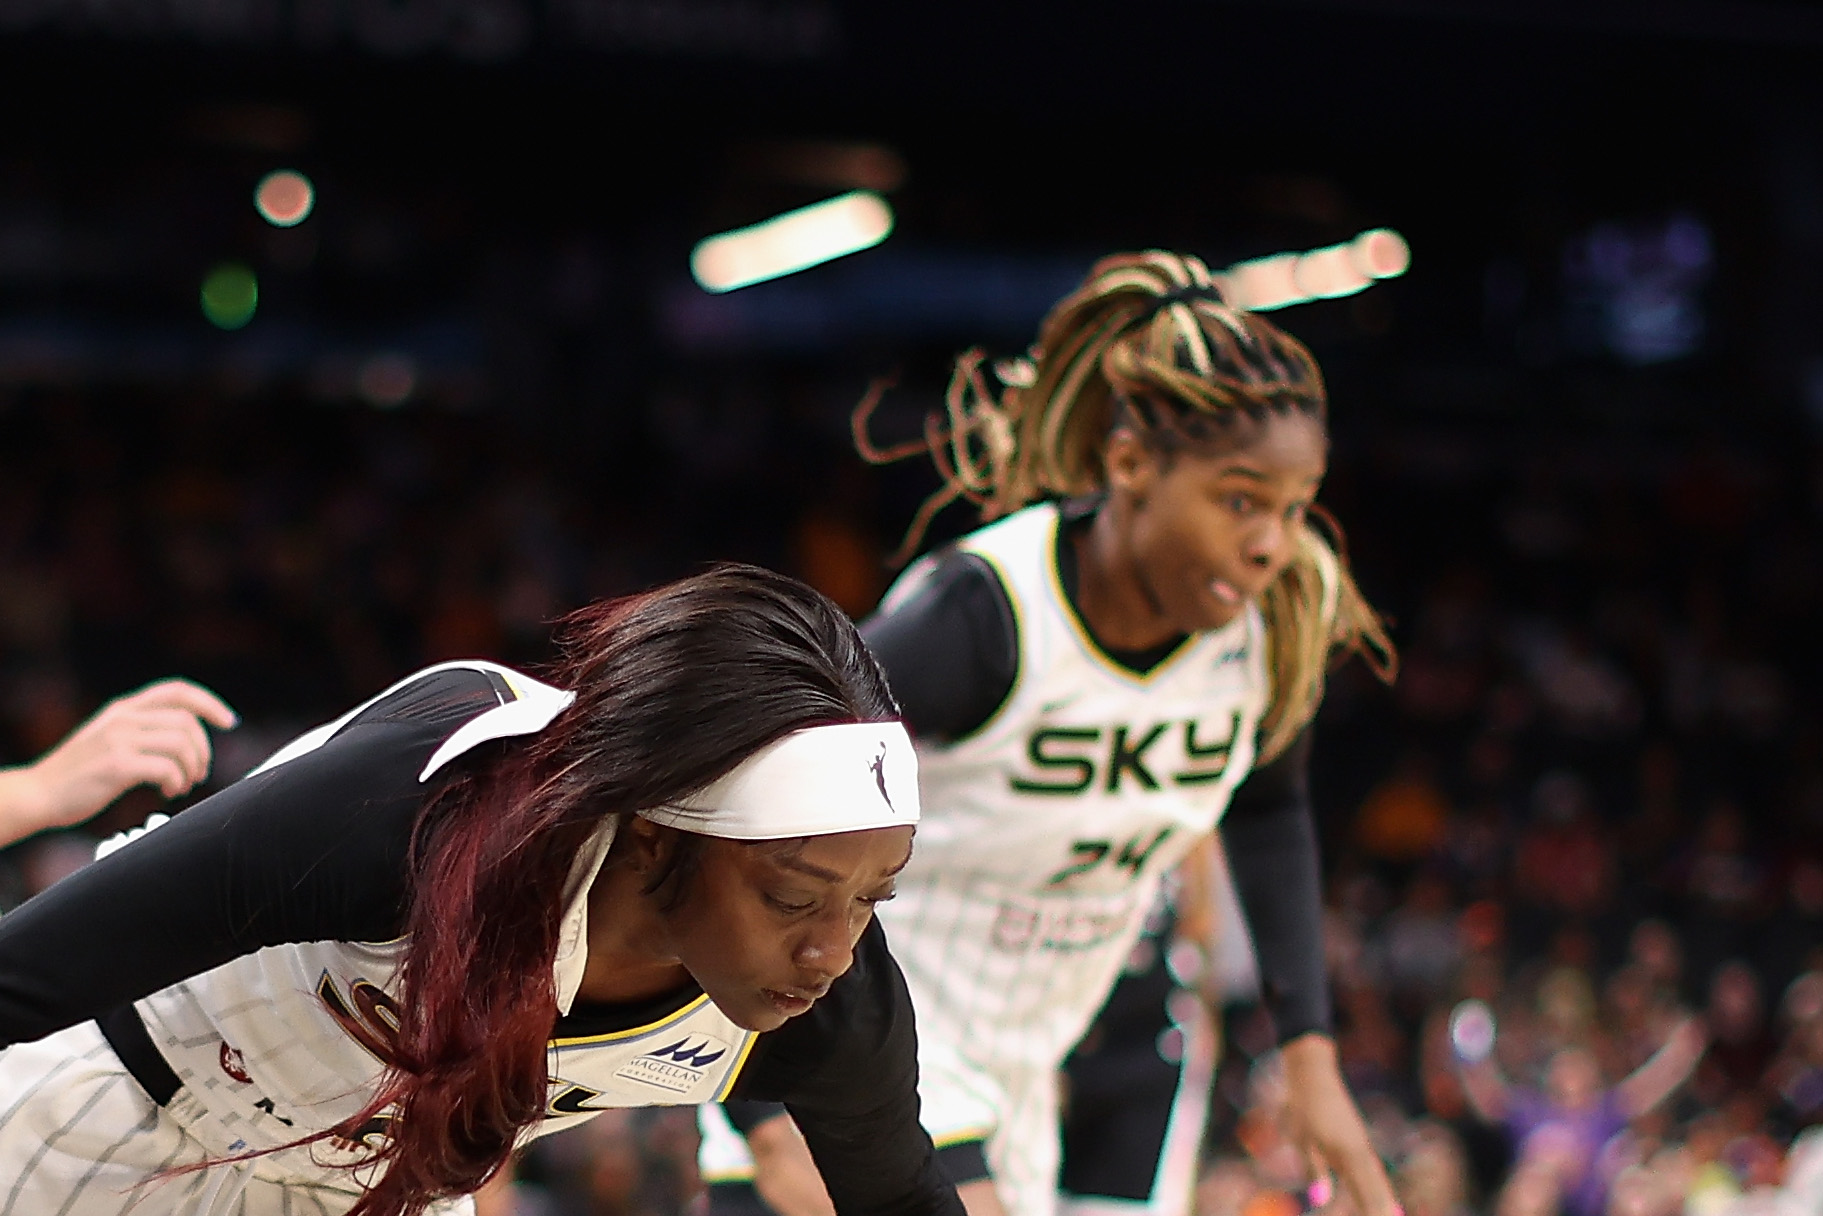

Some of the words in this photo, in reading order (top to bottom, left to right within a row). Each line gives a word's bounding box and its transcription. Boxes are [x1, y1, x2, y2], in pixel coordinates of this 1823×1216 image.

[1010, 711, 1241, 796] SKY
[619, 1068, 693, 1090] CORPORATION
[629, 1059, 701, 1083] MAGELLAN
